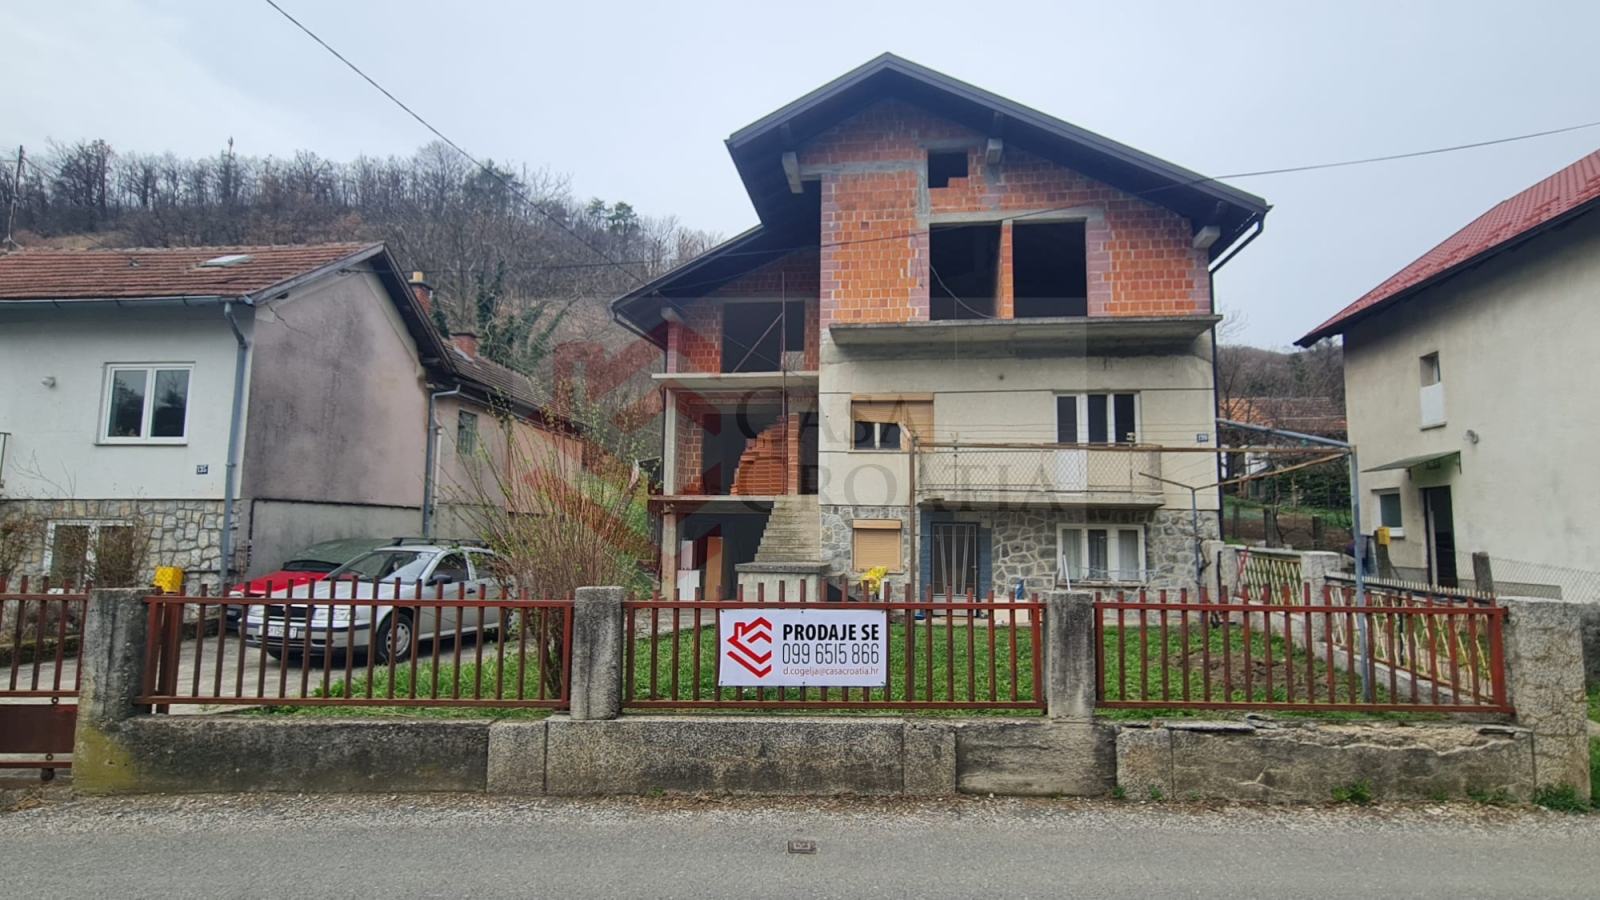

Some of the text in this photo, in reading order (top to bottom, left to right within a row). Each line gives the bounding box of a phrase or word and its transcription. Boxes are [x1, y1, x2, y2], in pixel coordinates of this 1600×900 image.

[783, 624, 879, 641] PRODAJE SE
[782, 643, 880, 664] 099 6515 866
[783, 666, 879, 676] d.cogelja@casacroatia.hr
